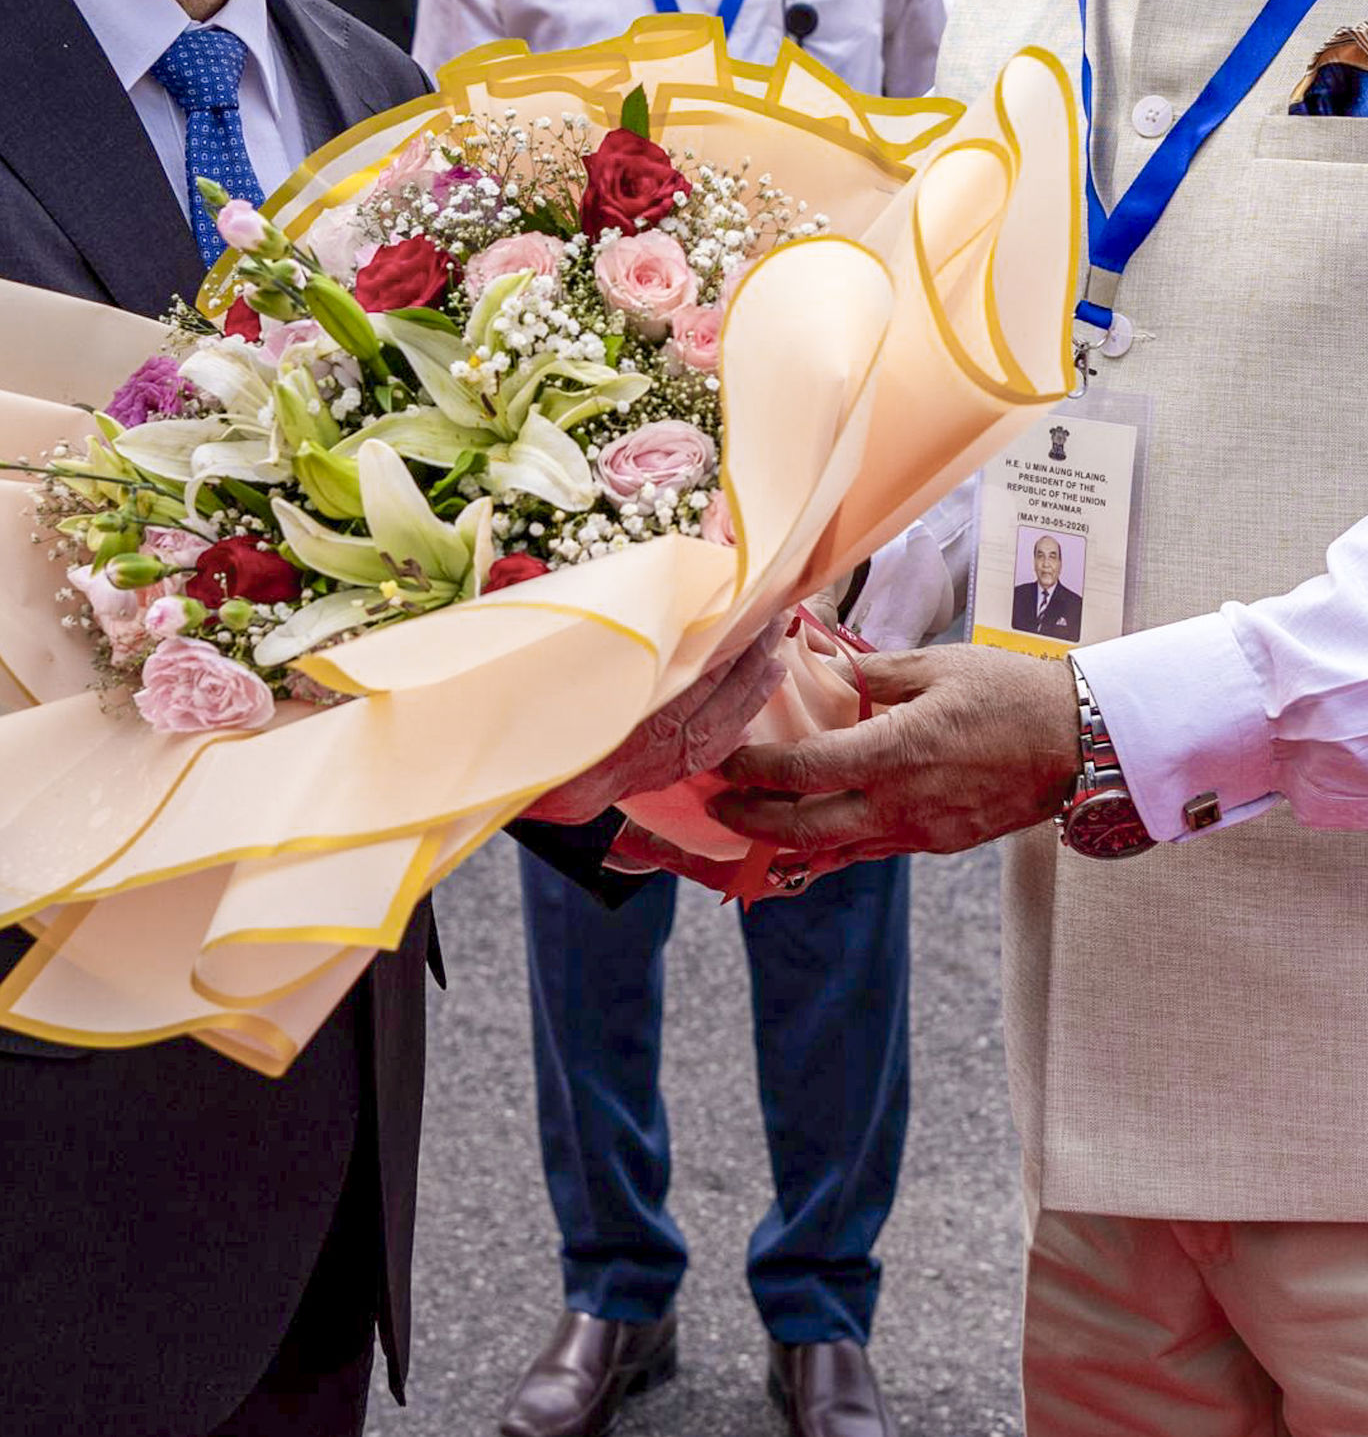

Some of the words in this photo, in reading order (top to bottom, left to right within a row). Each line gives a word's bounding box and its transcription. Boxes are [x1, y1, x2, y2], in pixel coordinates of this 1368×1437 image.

[1025, 462, 1031, 470] U
[1033, 463, 1048, 473] MIN
[1049, 466, 1073, 477] AUNG
[1019, 473, 1064, 488] PRESIDENT
[1066, 481, 1077, 489] OF
[1080, 483, 1096, 493] THE
[1007, 482, 1047, 497] REPUBLIC
[1049, 489, 1060, 499] OF
[1062, 492, 1078, 502] THE
[1080, 495, 1107, 507] UNION
[1028, 498, 1040, 506] OF
[1041, 500, 1082, 515] MYANMAR
[1017, 512, 1039, 523] (MAY
